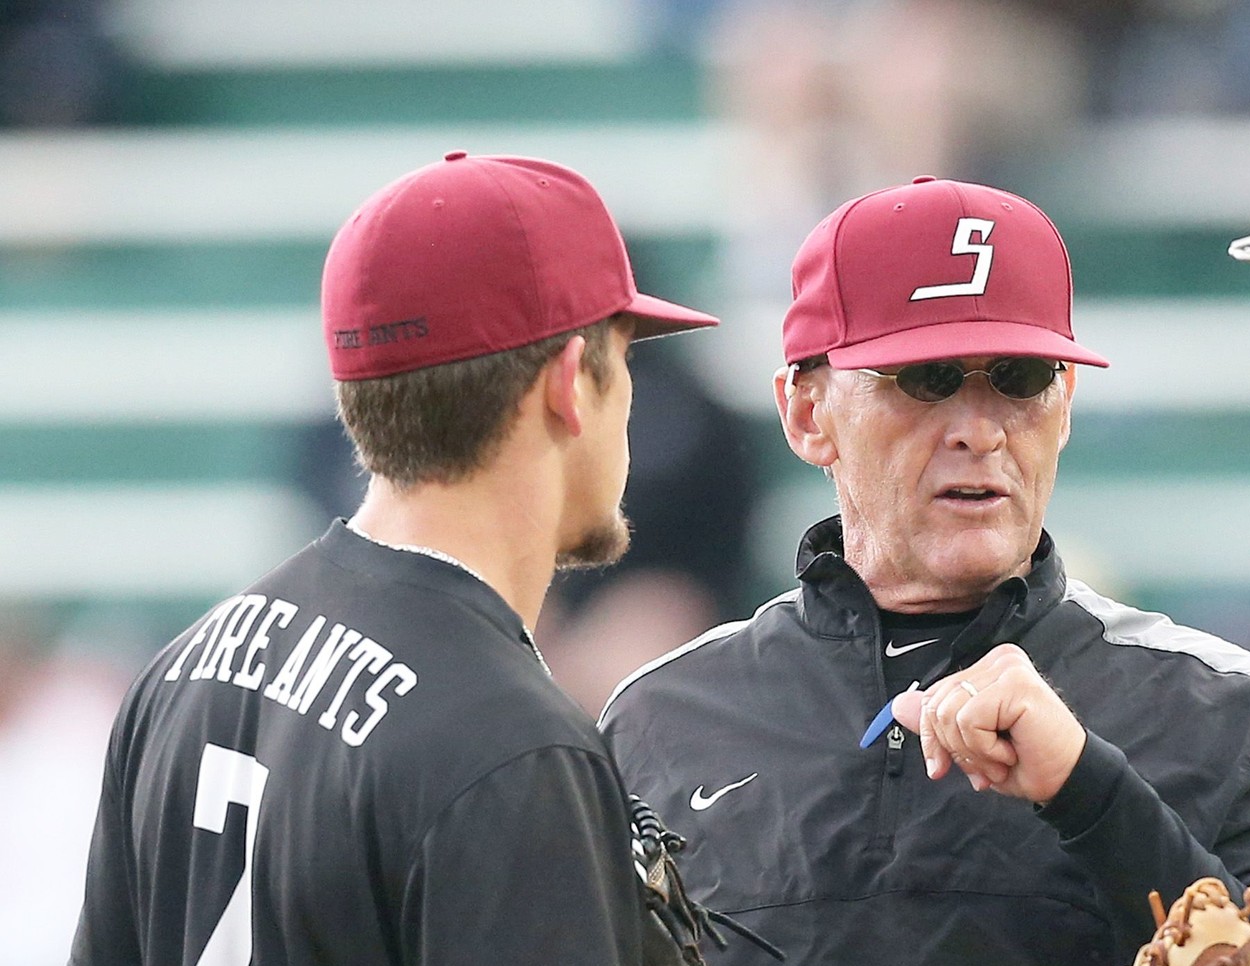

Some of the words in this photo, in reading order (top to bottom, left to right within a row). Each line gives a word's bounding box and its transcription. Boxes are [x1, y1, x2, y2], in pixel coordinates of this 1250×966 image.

[369, 316, 430, 346] ANTS
[164, 594, 299, 691] FIRE
[264, 615, 418, 747] ANTS
